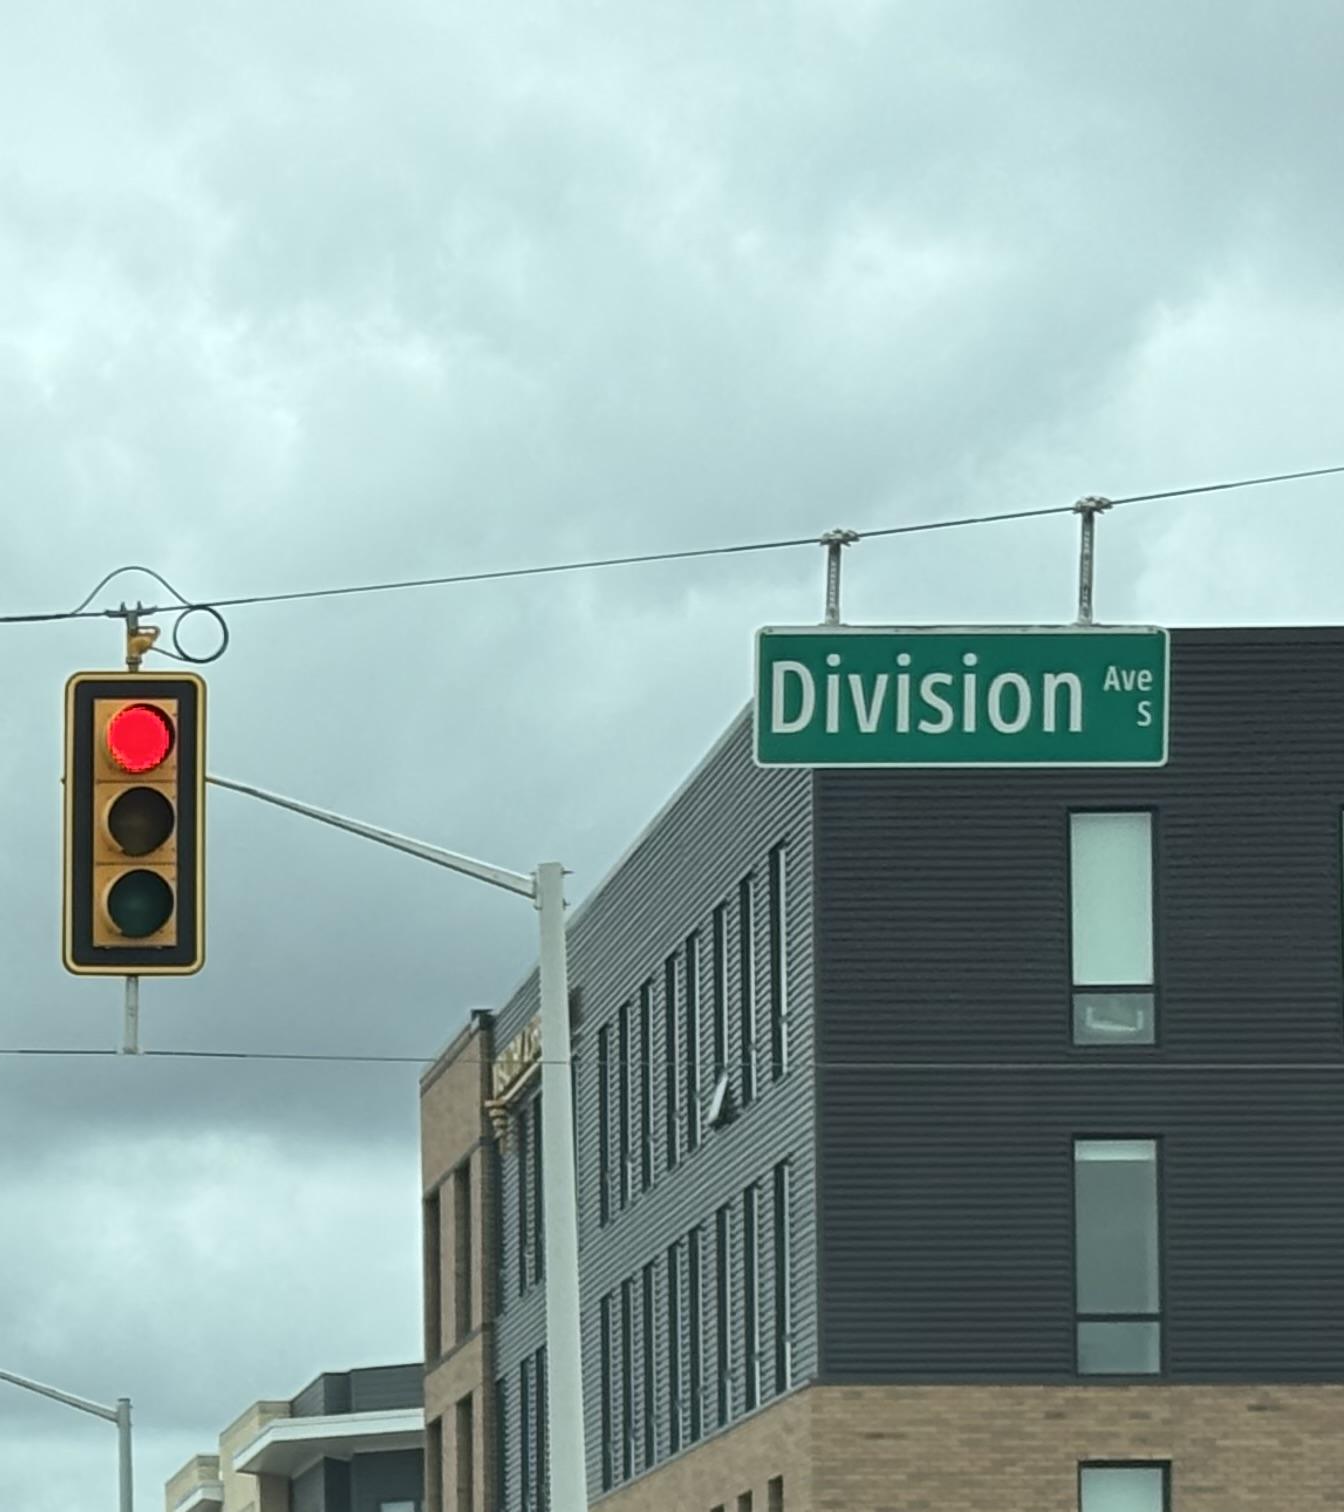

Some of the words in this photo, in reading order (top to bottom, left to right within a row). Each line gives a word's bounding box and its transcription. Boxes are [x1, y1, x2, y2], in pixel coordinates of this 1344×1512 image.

[1103, 665, 1153, 692] Ave
[771, 653, 1083, 734] Division
[1136, 701, 1153, 727] S
